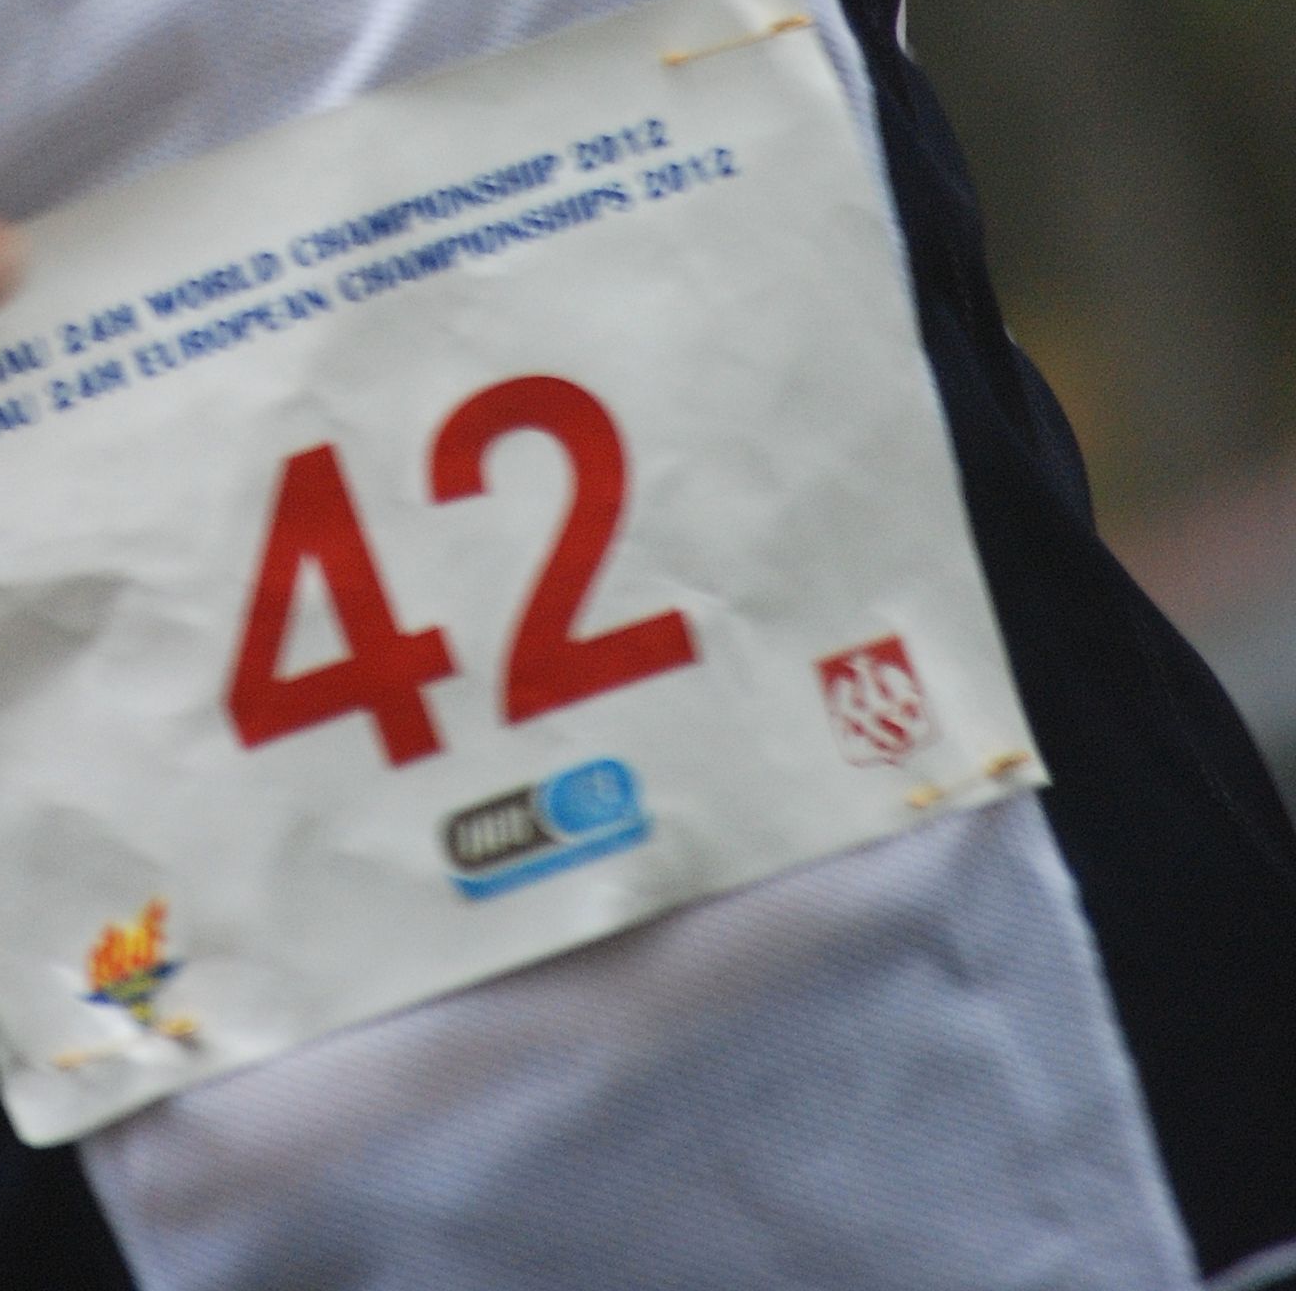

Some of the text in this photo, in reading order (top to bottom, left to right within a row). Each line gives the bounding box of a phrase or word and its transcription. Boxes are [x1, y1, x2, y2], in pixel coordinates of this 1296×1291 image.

[131, 287, 332, 377] EUROPEAN
[334, 181, 632, 303] CHAMPIONSHIPS
[636, 146, 740, 200] 2012
[144, 251, 284, 317] WORLD
[288, 152, 561, 268] CHAMPIONSHIP
[569, 118, 671, 171] 2012
[227, 375, 696, 767] 42
